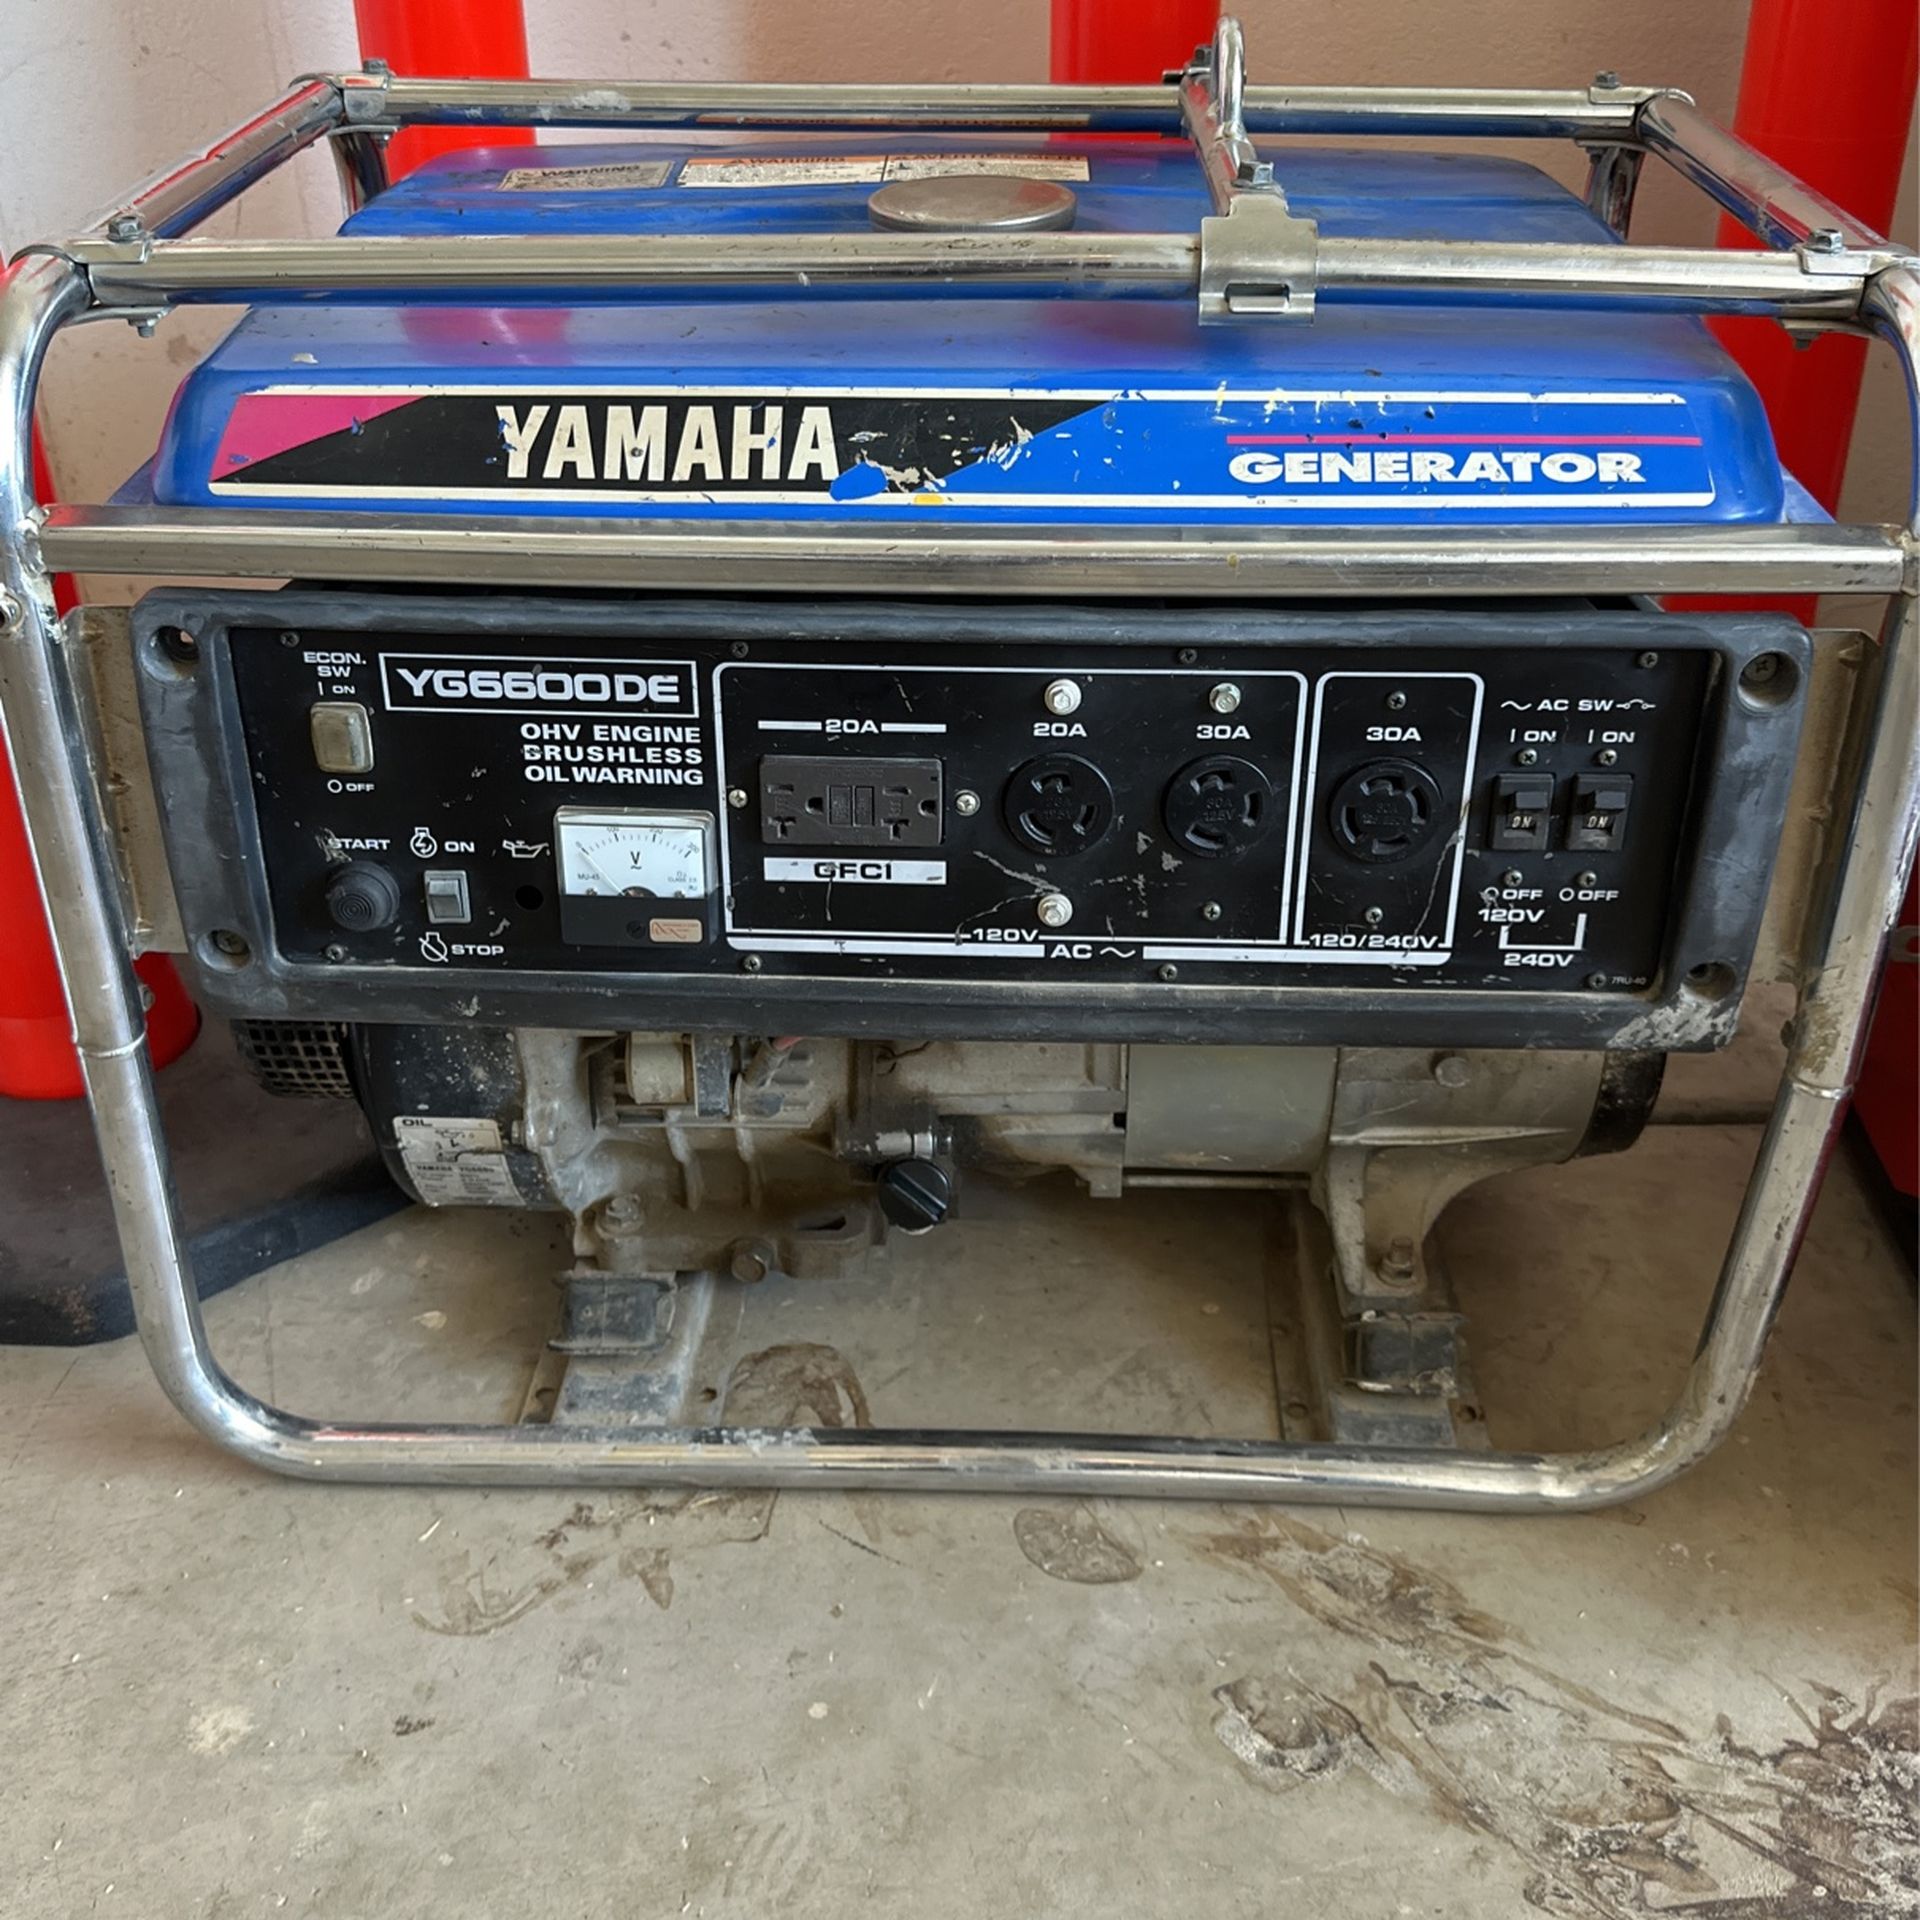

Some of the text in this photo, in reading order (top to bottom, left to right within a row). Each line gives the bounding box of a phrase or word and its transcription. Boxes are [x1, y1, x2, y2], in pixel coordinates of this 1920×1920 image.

[750, 157, 846, 165] WARNING
[540, 164, 641, 177] WARNING
[495, 405, 840, 481] YAMAHA
[1228, 452, 1646, 484] GENERATOR
[303, 652, 367, 665] ECON.
[317, 666, 351, 678] SW
[332, 684, 355, 695] ON
[397, 668, 680, 704] YG6600DE
[1536, 699, 1614, 711] AC SW
[521, 723, 701, 743] OHV ENGINE
[825, 719, 880, 734] 20A
[1033, 722, 1087, 738] 20A
[1196, 724, 1251, 741] 30A
[1366, 727, 1422, 742] 30A
[1523, 731, 1557, 743] ON
[1602, 731, 1635, 743] ON
[523, 745, 703, 764] BRUSHLESS
[525, 766, 704, 785] OIL WARNING
[346, 782, 375, 793] OFF
[327, 838, 390, 850] START
[445, 841, 475, 853] ON
[630, 851, 641, 865] V
[814, 861, 892, 880] GFCI
[1502, 888, 1543, 900] OFF
[1578, 889, 1619, 901] OFF
[1478, 908, 1545, 923] 120V
[972, 927, 1039, 942] 120V
[1309, 934, 1440, 949] 120/240V
[451, 944, 504, 956] STOP
[1050, 944, 1092, 959] AC
[1504, 953, 1575, 967] 240V
[402, 1118, 433, 1127] OIL
